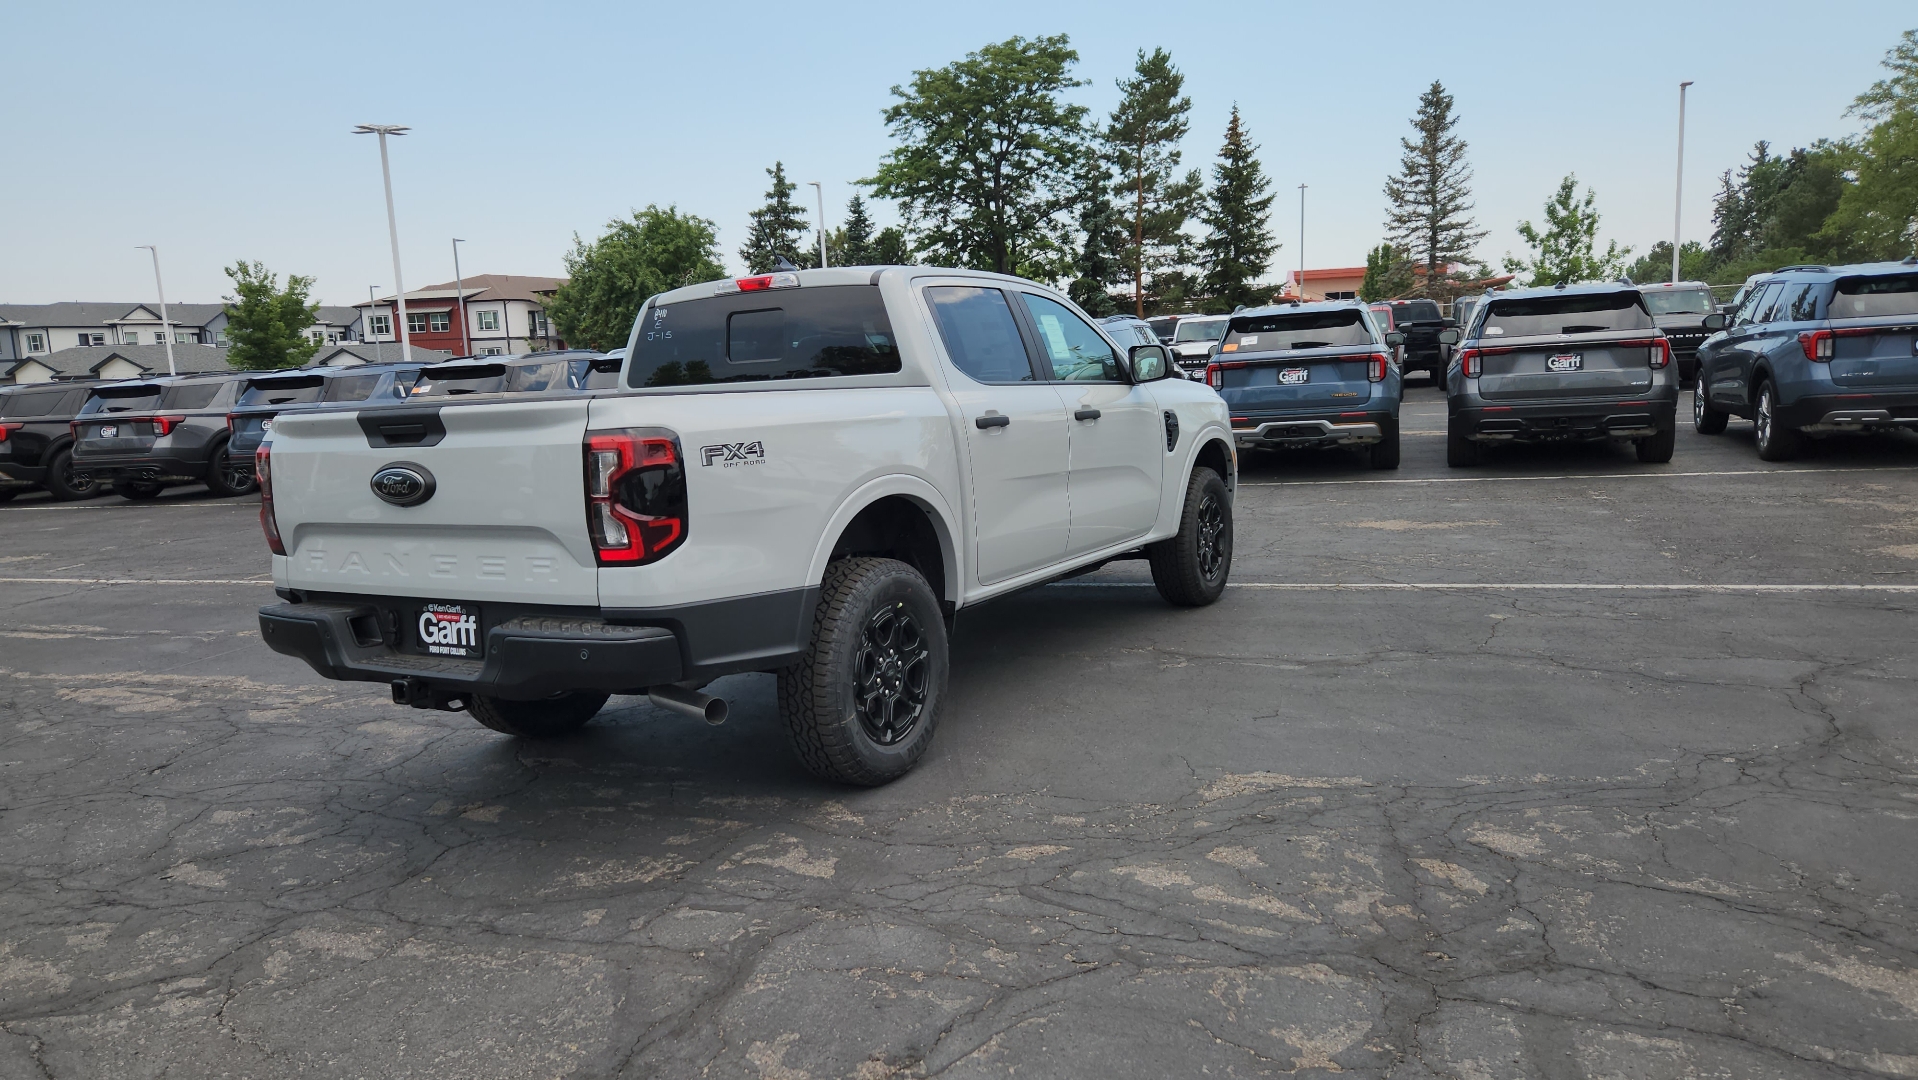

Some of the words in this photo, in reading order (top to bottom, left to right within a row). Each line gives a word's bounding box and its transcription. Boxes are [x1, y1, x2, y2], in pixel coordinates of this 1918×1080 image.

[1548, 355, 1581, 369] Garff
[1279, 370, 1308, 382] Garff
[700, 441, 765, 467] FX4
[381, 475, 411, 495] Ford
[303, 549, 560, 583] RANGER
[419, 611, 477, 646] Garff
